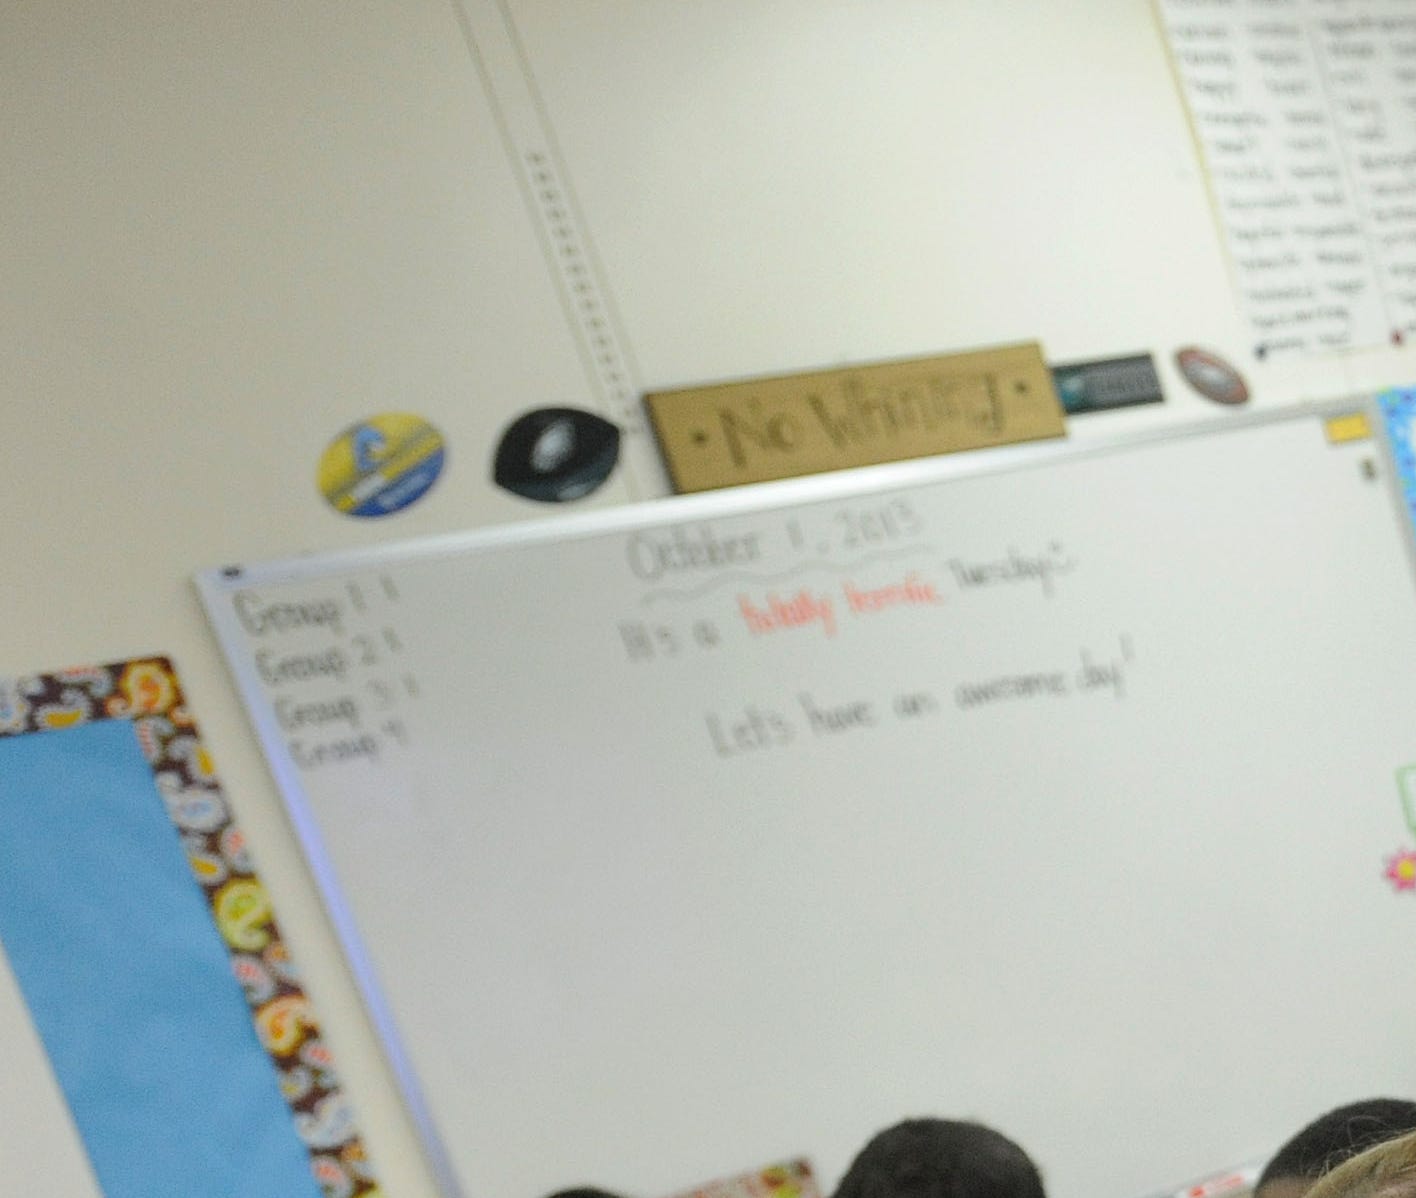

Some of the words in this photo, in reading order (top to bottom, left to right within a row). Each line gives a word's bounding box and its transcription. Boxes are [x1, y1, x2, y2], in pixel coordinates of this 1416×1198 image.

[714, 397, 796, 468] No
[232, 588, 344, 638] Group
[254, 646, 347, 688] Group
[273, 695, 361, 733] Group
[800, 692, 880, 739] have
[953, 667, 1069, 711] awesome
